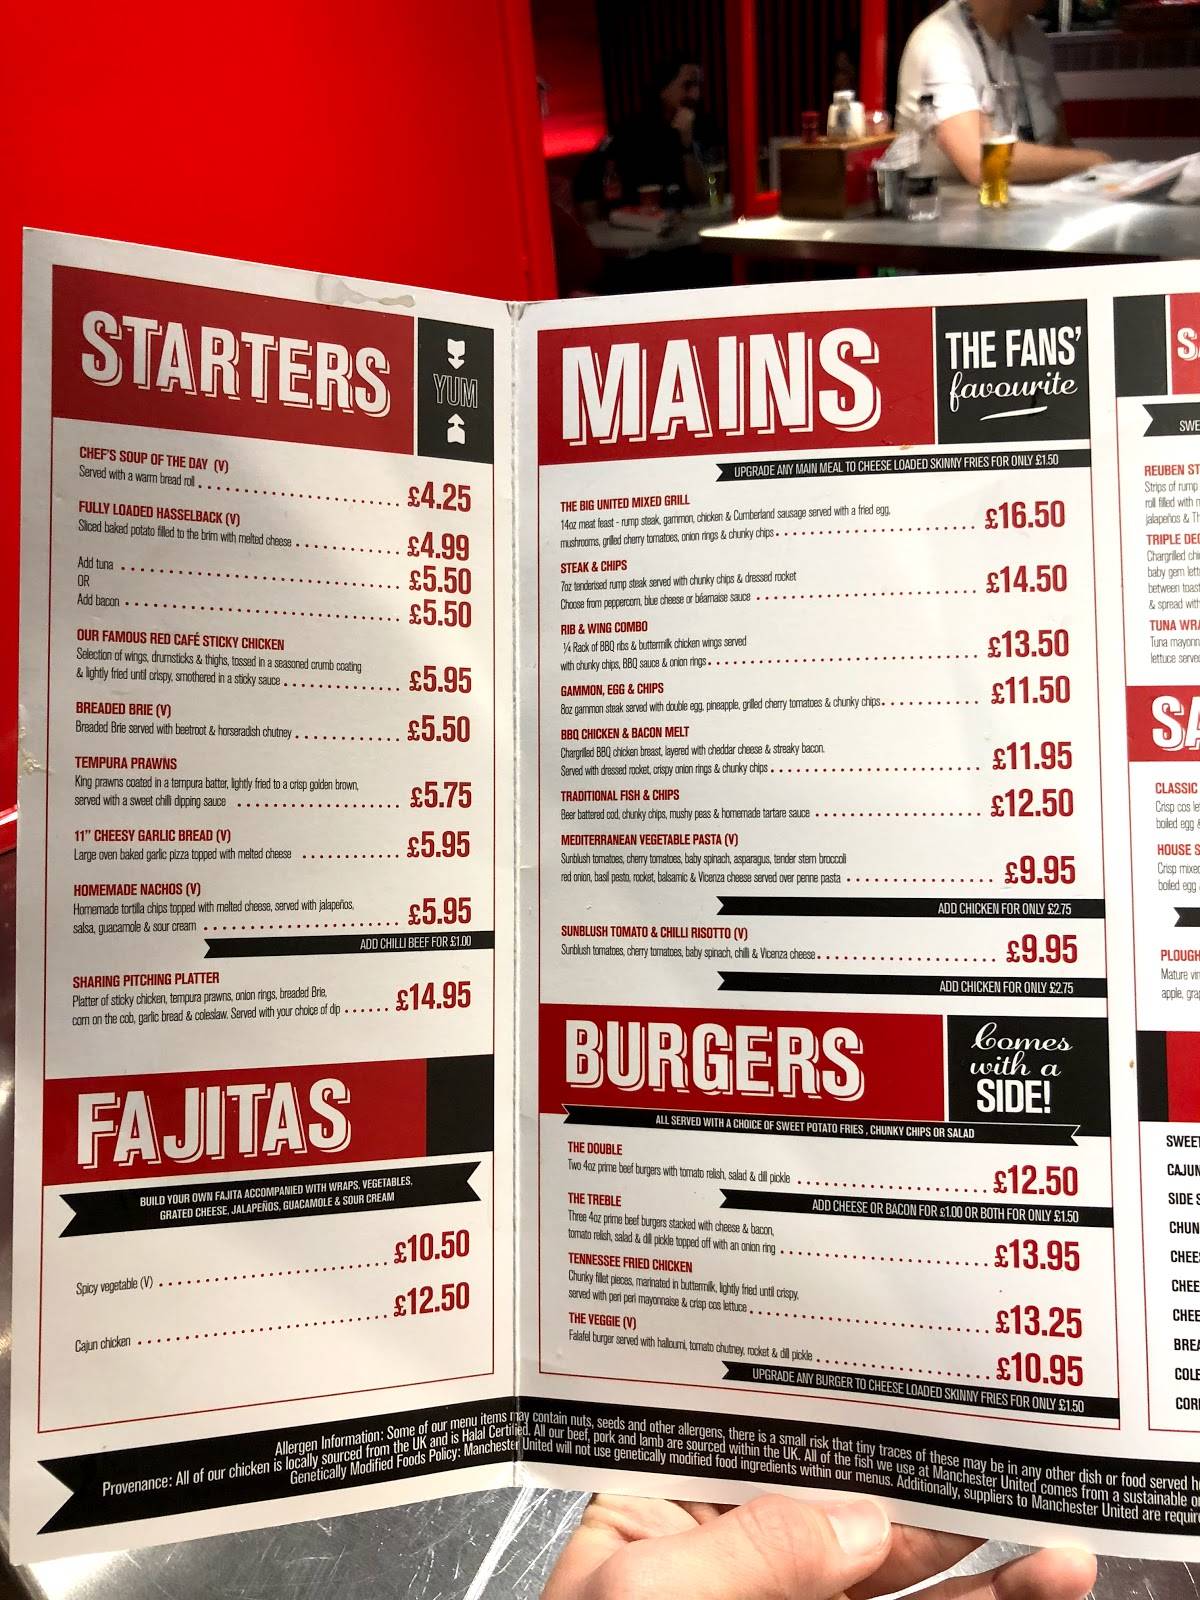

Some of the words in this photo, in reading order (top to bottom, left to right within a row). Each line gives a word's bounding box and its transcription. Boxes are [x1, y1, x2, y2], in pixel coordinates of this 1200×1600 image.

[945, 331, 996, 369] THE
[1006, 326, 1081, 367] FANS'
[82, 311, 390, 417] STARTERS
[433, 374, 478, 408] YUM
[563, 328, 881, 446] MAINS
[949, 370, 1079, 413] favourite
[80, 446, 116, 461] CHEF'S
[120, 450, 148, 464] SOUP
[151, 454, 164, 466] OF
[166, 455, 186, 468] THE
[189, 457, 208, 470] DAY
[214, 460, 228, 474] (V)
[1145, 464, 1184, 476] REUBEN
[79, 465, 106, 479] Served
[109, 469, 126, 480] with
[128, 472, 133, 481] a
[136, 474, 158, 484] warm
[160, 473, 182, 486] bread
[184, 476, 195, 487] roll
[408, 482, 471, 512] £4.25
[560, 501, 577, 512] THE
[580, 500, 594, 511] BIG
[597, 498, 629, 510] UNITED
[632, 496, 662, 508] MIXED
[665, 494, 690, 506] GRILL
[79, 501, 110, 514] FULLY
[113, 504, 153, 518] LOADED
[157, 507, 222, 524] HASSELBACK
[226, 513, 240, 527] (V)
[985, 500, 1065, 529] £16.50
[407, 532, 469, 561] £4.99
[1146, 534, 1181, 545] TRIPLE
[409, 565, 471, 594] £5.50
[561, 562, 589, 574] STEAK
[592, 562, 598, 572] &
[601, 560, 627, 572] CHIPS
[986, 564, 1067, 594] £14.50
[409, 599, 472, 628] £5.50
[1150, 620, 1176, 631] TUNA
[77, 628, 99, 642] OUR
[102, 630, 147, 644] FAMOUS
[150, 632, 171, 644] RED
[174, 632, 200, 646] CAFÉ
[203, 635, 238, 648] STICKY
[242, 638, 284, 650] CHICKEN
[561, 624, 576, 635] RIB
[578, 624, 585, 634] &
[588, 623, 612, 634] WING
[615, 621, 648, 633] COMBO
[988, 629, 1069, 658] £13.50
[409, 666, 472, 694] £5.95
[561, 685, 605, 696] GAMMON,
[608, 684, 625, 695] EGG
[628, 684, 634, 694] &
[638, 683, 664, 694] CHIPS
[991, 676, 1070, 704] £11.50
[76, 702, 126, 714] BREADED
[129, 704, 153, 716] BRIE
[156, 704, 171, 718] (V)
[408, 715, 470, 742] £5.50
[561, 729, 579, 740] BBQ
[582, 728, 620, 740] CHICKEN
[622, 728, 629, 738] &
[632, 727, 662, 738] BACON
[665, 726, 690, 737] MELT
[75, 756, 128, 769] TEMPURA
[131, 758, 177, 770] PRAWNS
[992, 742, 1072, 770] £11.95
[410, 782, 472, 808] £5.75
[561, 790, 618, 802] TRADITIONAL
[620, 790, 640, 801] FISH
[643, 790, 650, 800] &
[653, 790, 679, 800] CHIPS
[1156, 782, 1198, 794] CLASSIC
[991, 788, 1074, 817] £12.50
[94, 830, 135, 842] CHEESY
[138, 830, 175, 842] GARLIC
[179, 830, 213, 841] BREAD
[217, 829, 231, 844] (V)
[407, 831, 470, 858] £5.95
[562, 834, 637, 846] MEDITERRANEAN
[640, 834, 690, 845] VEGETABLE
[693, 834, 722, 845] PASTA
[725, 834, 738, 847] (V)
[1158, 844, 1192, 856] HOUSE
[1005, 856, 1075, 884] £9.95
[74, 884, 137, 896] HOMEMADE
[140, 883, 182, 895] NACHOS
[186, 883, 200, 896] (V)
[408, 897, 471, 926] £5.95
[938, 903, 957, 914] ADD
[960, 903, 999, 914] CHICKEN
[1002, 903, 1020, 914] FOR
[1022, 903, 1045, 915] ONLY
[1047, 903, 1072, 915] £2.75
[360, 938, 378, 950] ADD
[380, 937, 406, 949] CHILLI
[408, 936, 429, 948] BEEF
[431, 936, 448, 947] FOR
[450, 935, 472, 947] £1.00
[562, 926, 608, 937] SUNBLUSH
[610, 926, 648, 938] TOMATO
[651, 926, 658, 938] &
[661, 927, 688, 938] CHILLI
[692, 927, 731, 939] RISOTTO
[734, 928, 748, 941] (V)
[1006, 934, 1077, 964] £9.95
[73, 975, 120, 988] SHARING
[124, 974, 172, 986] PITCHING
[175, 972, 219, 984] PLATTER
[396, 981, 471, 1011] £14.95
[971, 1022, 1072, 1054] Comes
[566, 1020, 864, 1101] BURGERS
[970, 1051, 1031, 1076] with
[1041, 1064, 1061, 1076] a
[977, 1079, 1050, 1114] SIDE!
[78, 1078, 351, 1169] FAJITAS
[568, 1142, 585, 1153] THE
[588, 1143, 622, 1156] DOUBLE
[994, 1165, 1078, 1196] £12.50
[568, 1192, 585, 1204] THE
[587, 1194, 621, 1207] TREBLE
[1169, 1192, 1193, 1205] SIDE
[394, 1230, 469, 1264] £10.50
[994, 1239, 1080, 1271] £13.95
[568, 1252, 620, 1267] TENNESSEE
[624, 1257, 650, 1270] FRIED
[653, 1259, 692, 1273] CHICKEN
[76, 1282, 98, 1296] Spicy
[101, 1278, 138, 1294] vegetable
[140, 1276, 153, 1290] (V)
[394, 1282, 469, 1317] £12.50
[569, 1312, 586, 1324] THE
[588, 1314, 620, 1327] VEGGIE
[623, 1316, 636, 1330] (V)
[996, 1305, 1082, 1338] £13.25
[75, 1340, 98, 1354] Cajun
[101, 1336, 130, 1350] chicken
[996, 1352, 1083, 1386] £10.95
[290, 1464, 347, 1484] Genetically
[350, 1458, 394, 1476] Modified
[397, 1454, 426, 1468] Foods
[428, 1449, 461, 1462] Policy:
[464, 1440, 519, 1457] Manchester
